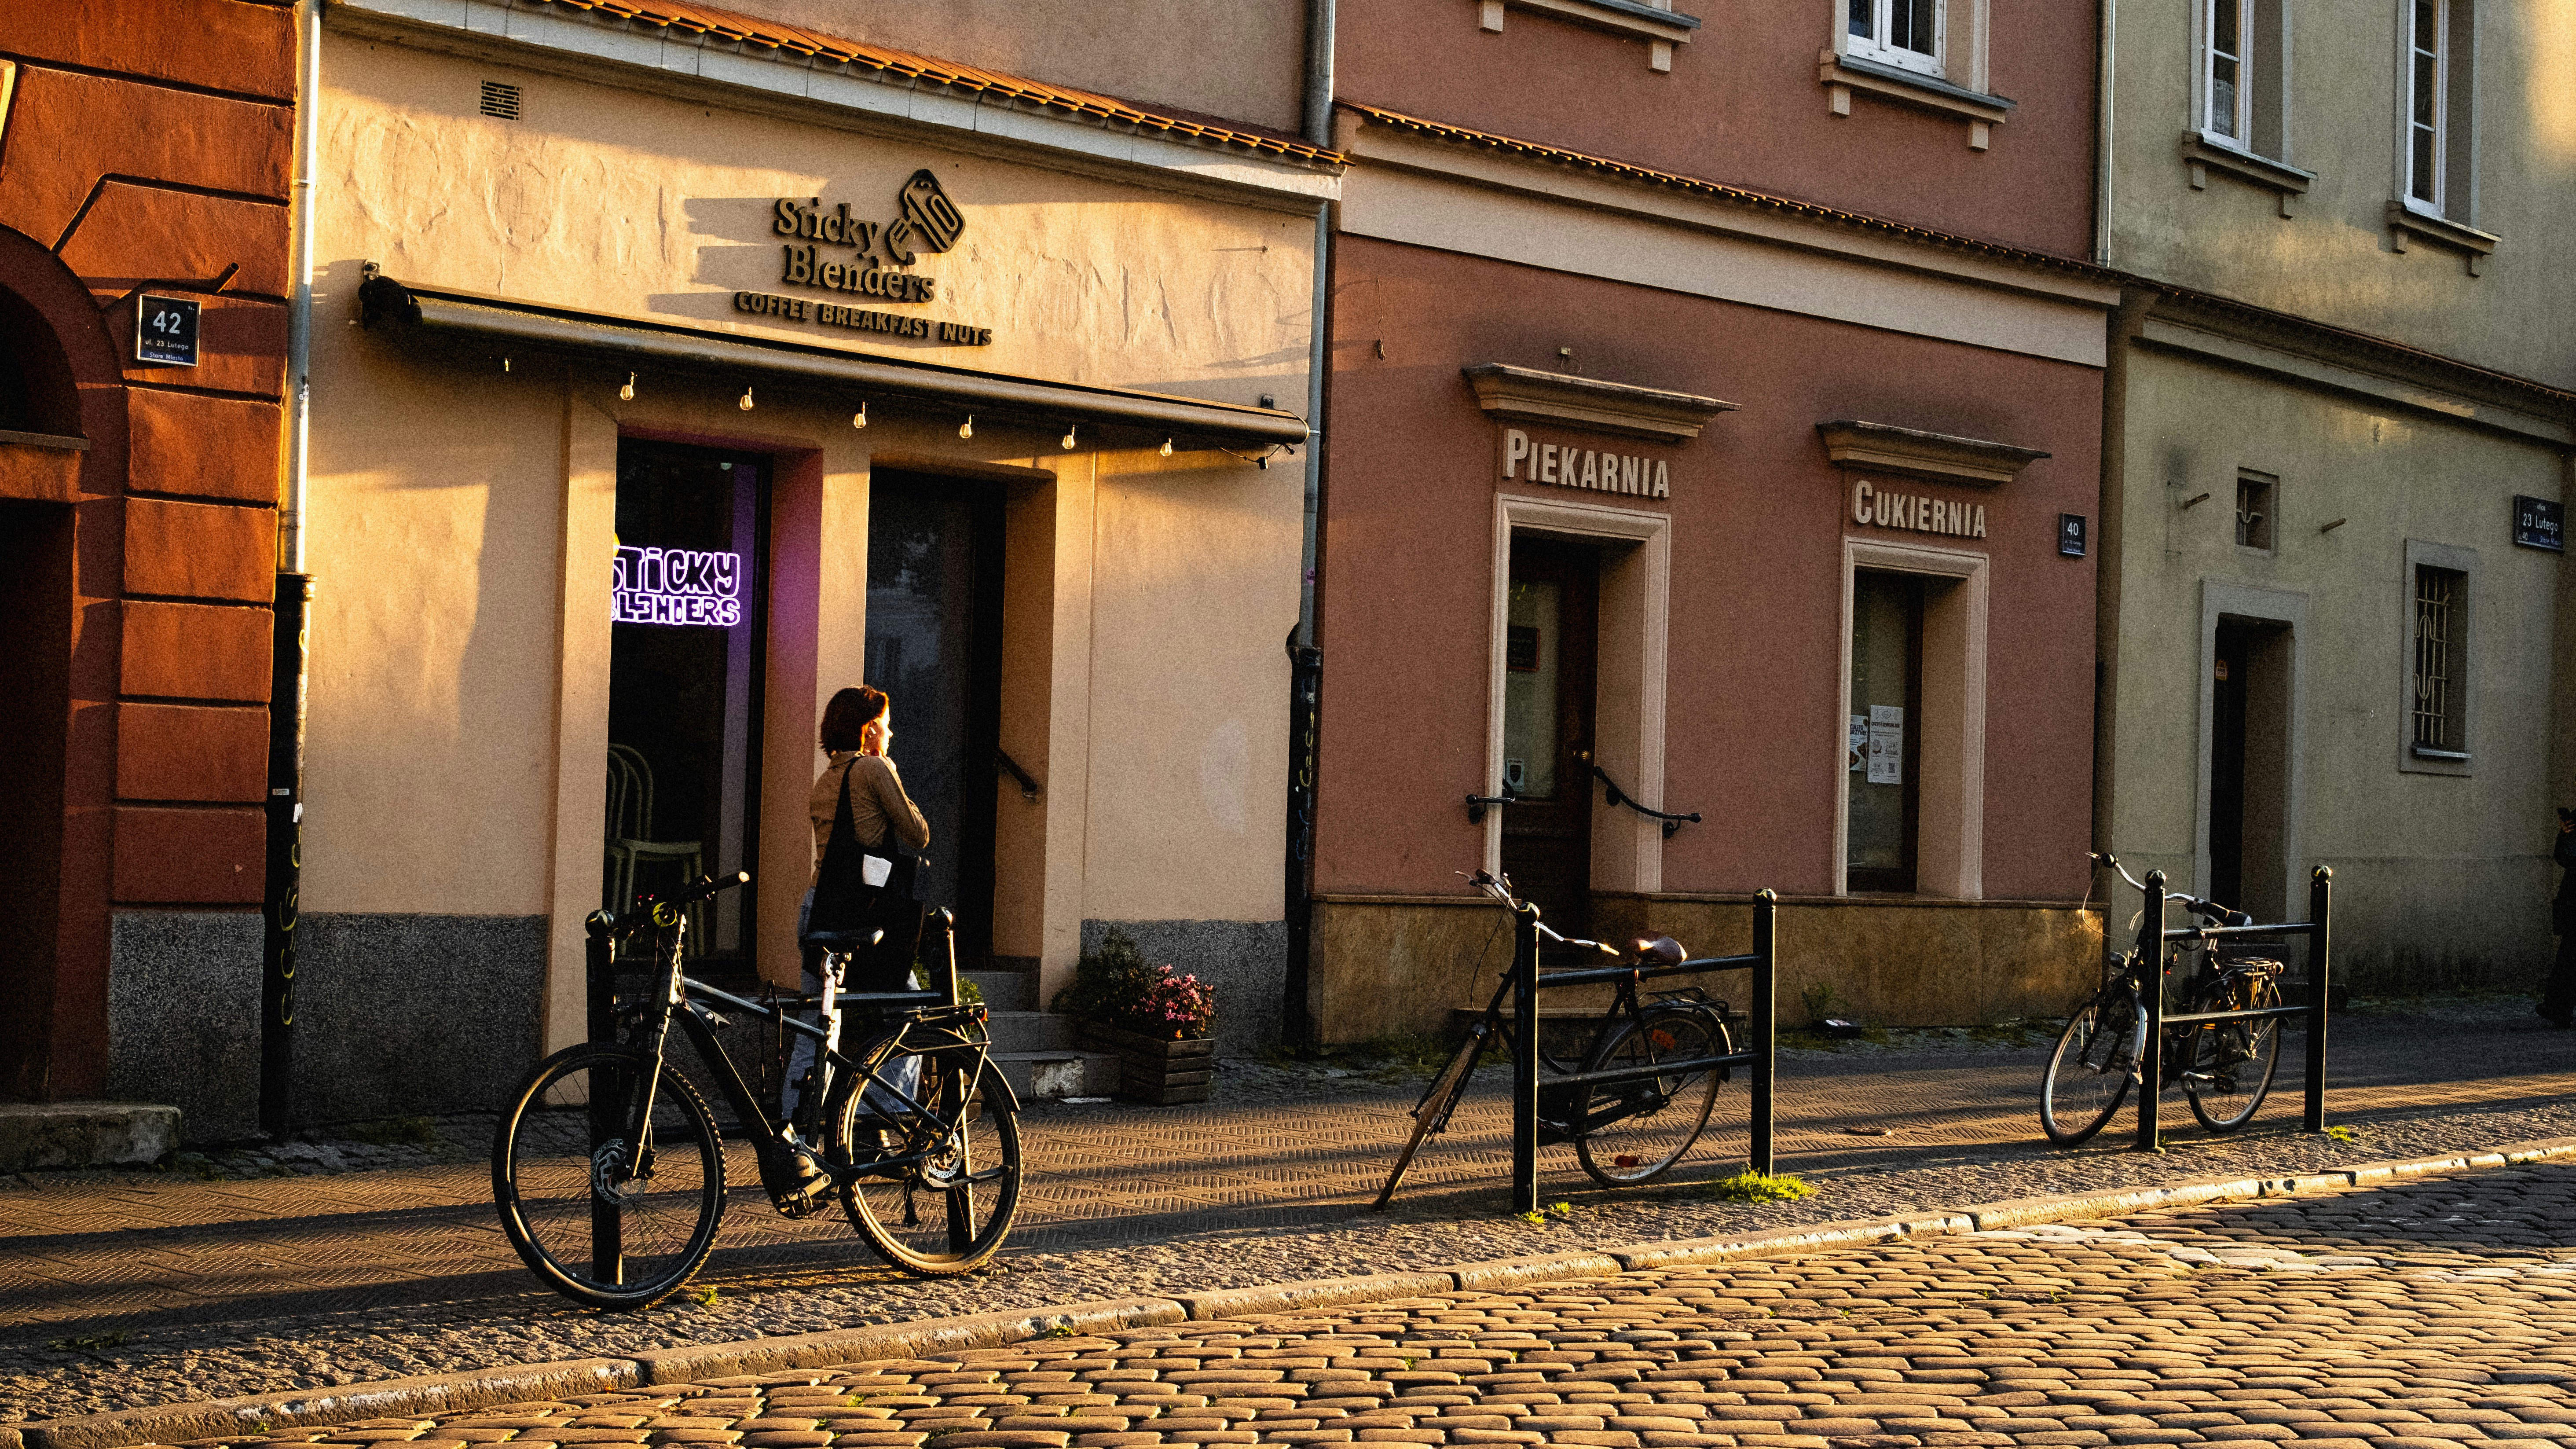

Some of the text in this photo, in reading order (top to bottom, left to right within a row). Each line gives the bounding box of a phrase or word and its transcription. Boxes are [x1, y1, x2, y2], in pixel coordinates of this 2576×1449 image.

[774, 197, 880, 259] Sticky
[783, 244, 935, 303] Blenders
[153, 311, 181, 334] 42
[734, 291, 993, 346] COFFEE BREAKFAST NUTS
[168, 341, 189, 351] Lutego
[2067, 522, 2078, 536] 40
[2523, 513, 2558, 535] 23 Lutego
[2522, 532, 2528, 540] 40
